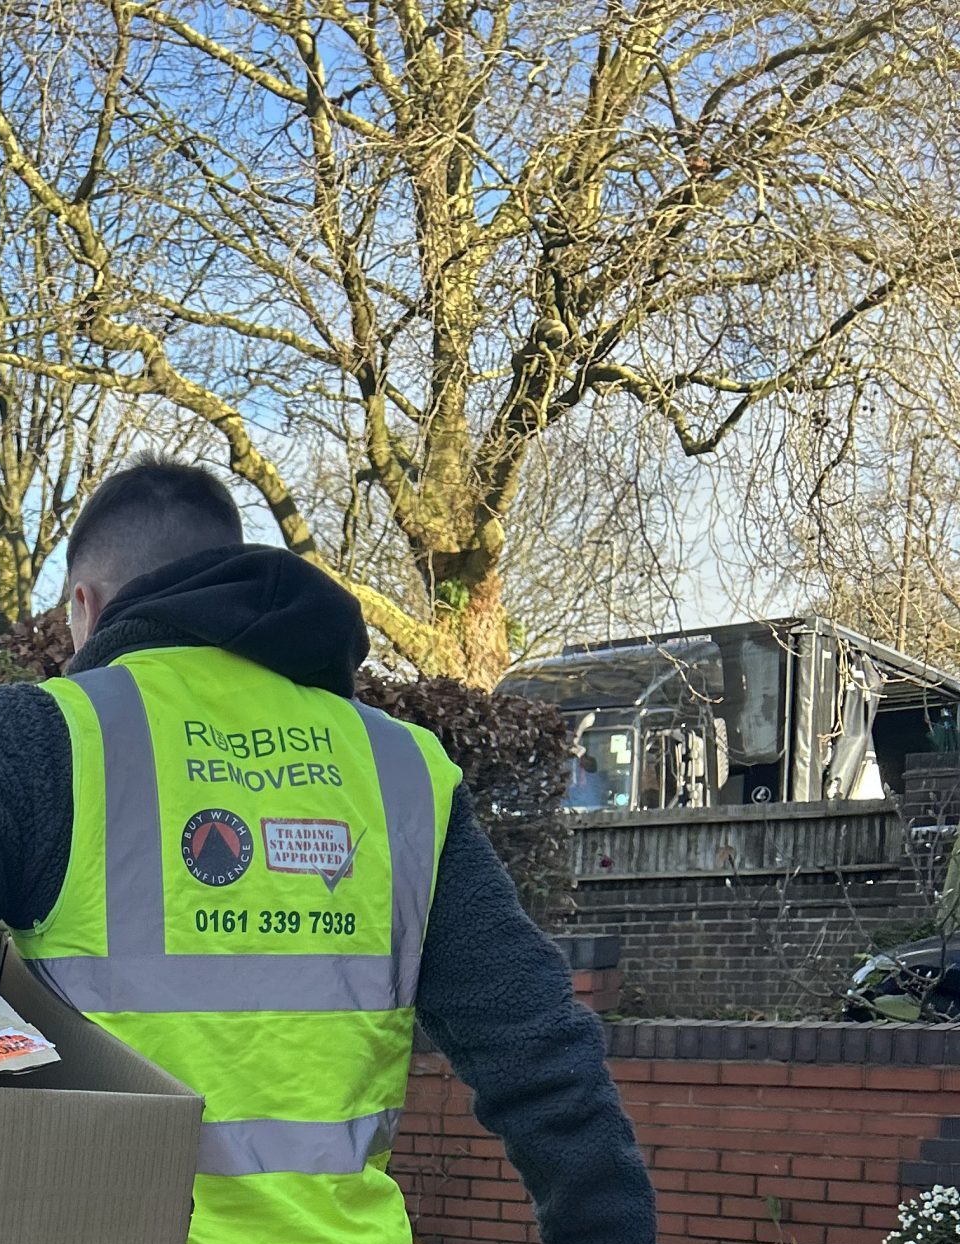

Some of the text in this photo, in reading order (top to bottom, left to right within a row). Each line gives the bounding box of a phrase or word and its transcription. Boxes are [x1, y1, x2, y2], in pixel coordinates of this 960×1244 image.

[184, 720, 333, 759] RUBBISH
[186, 759, 343, 792] REMOVERS
[184, 811, 247, 839] BUY WITH
[275, 828, 334, 840] TRADING
[269, 839, 345, 854] STANDARDS
[274, 851, 342, 865] APPROVED
[182, 844, 251, 884] CONFIDENCE
[195, 909, 356, 935] 0161 339 7938
